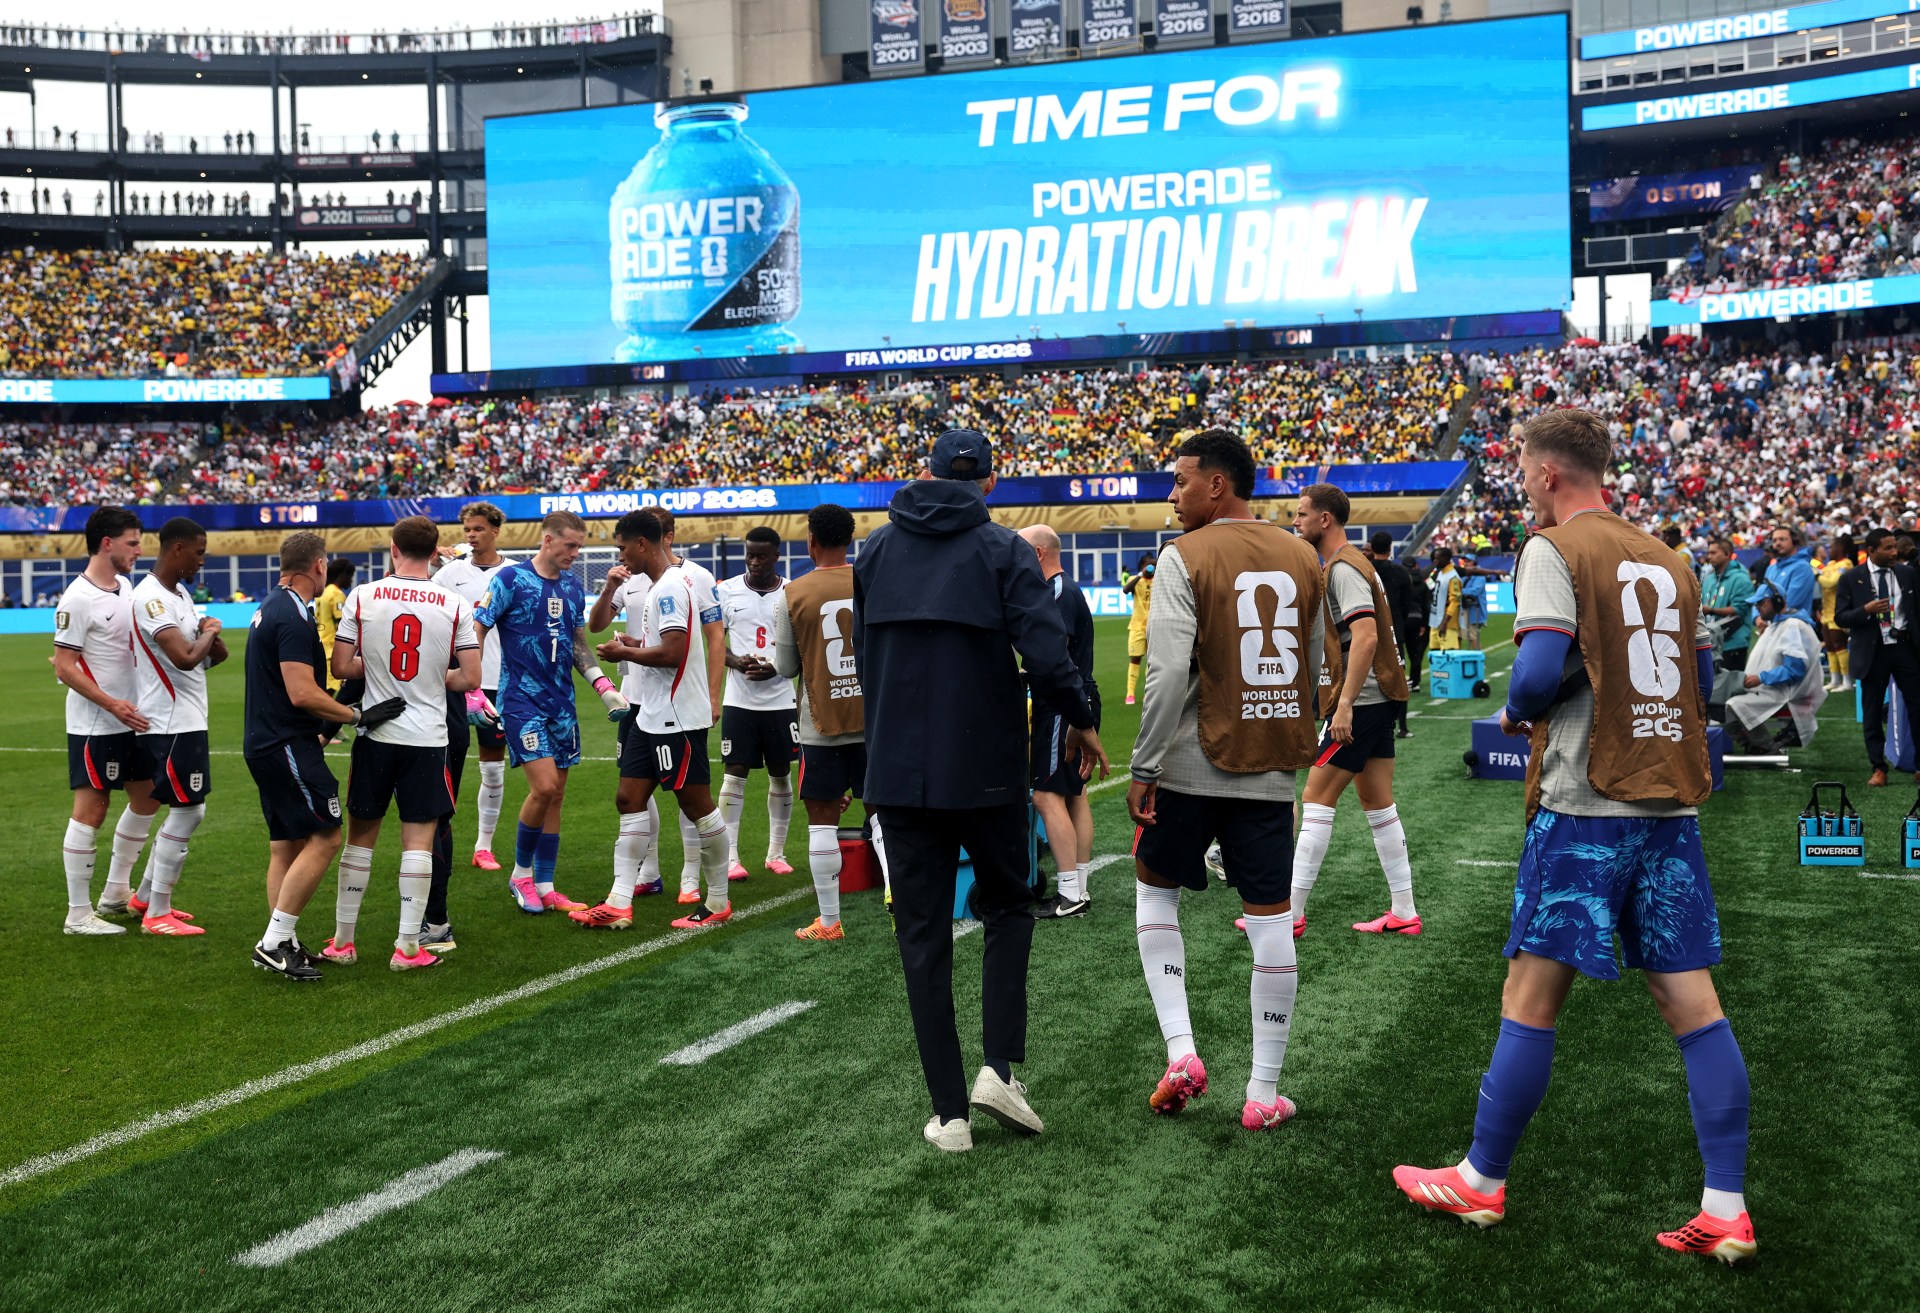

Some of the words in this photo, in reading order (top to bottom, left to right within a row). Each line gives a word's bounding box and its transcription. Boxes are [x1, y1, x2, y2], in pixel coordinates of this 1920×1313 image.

[1093, 9, 1125, 20] WORLD
[1158, 9, 1208, 22] CHAMPIONS
[1167, 2, 1199, 12] WORLD
[1233, 1, 1284, 14] CHAMPIONS
[1084, 17, 1133, 29] CHAMPIONS
[1162, 18, 1205, 35] 2016
[1237, 9, 1281, 27] 2018
[881, 32, 911, 42] WORLD
[942, 32, 988, 44] CHAMPIONS
[950, 25, 980, 35] WORLD
[1087, 25, 1131, 43] 2014
[1635, 10, 1788, 51] POWERADE
[873, 40, 919, 51] CHAMPIONS
[943, 40, 988, 57] 2003
[876, 47, 916, 64] 2001
[966, 85, 1153, 147] TIME
[1163, 68, 1341, 131] FOR
[1636, 84, 1789, 124] POWERADE
[1033, 164, 1275, 218] POWERADE
[321, 210, 353, 225] 2021
[356, 214, 395, 224] WINNERS
[622, 196, 762, 243] POWER
[911, 212, 1222, 323] HYDRATION
[1225, 197, 1429, 304] BREAK
[1700, 281, 1874, 323] POWERADE
[845, 352, 880, 367] FIFA
[881, 347, 938, 364] WORLD
[940, 345, 973, 361] CUP
[974, 342, 1032, 359] 2026
[144, 378, 285, 401] POWERADE
[540, 495, 583, 514] FIFA
[584, 492, 657, 513] WORLD
[659, 491, 701, 510] CUP
[703, 488, 778, 509] 2026
[373, 586, 446, 607] ANDERSON
[756, 626, 766, 649] 6
[389, 613, 422, 682] 8
[551, 637, 557, 662] 1
[840, 660, 856, 669] FIF
[1258, 663, 1285, 675] FIFA
[830, 677, 858, 687] WORLD
[830, 684, 862, 699] 202
[1242, 691, 1280, 701] WORLD
[1281, 690, 1298, 700] CUP
[1242, 701, 1300, 720] 2026
[789, 721, 800, 744] 6
[656, 744, 673, 771] 10
[1489, 752, 1521, 767] FIFA
[1807, 847, 1859, 855] POWERADE
[1164, 964, 1183, 977] ENG
[1264, 1011, 1287, 1024] ENG
